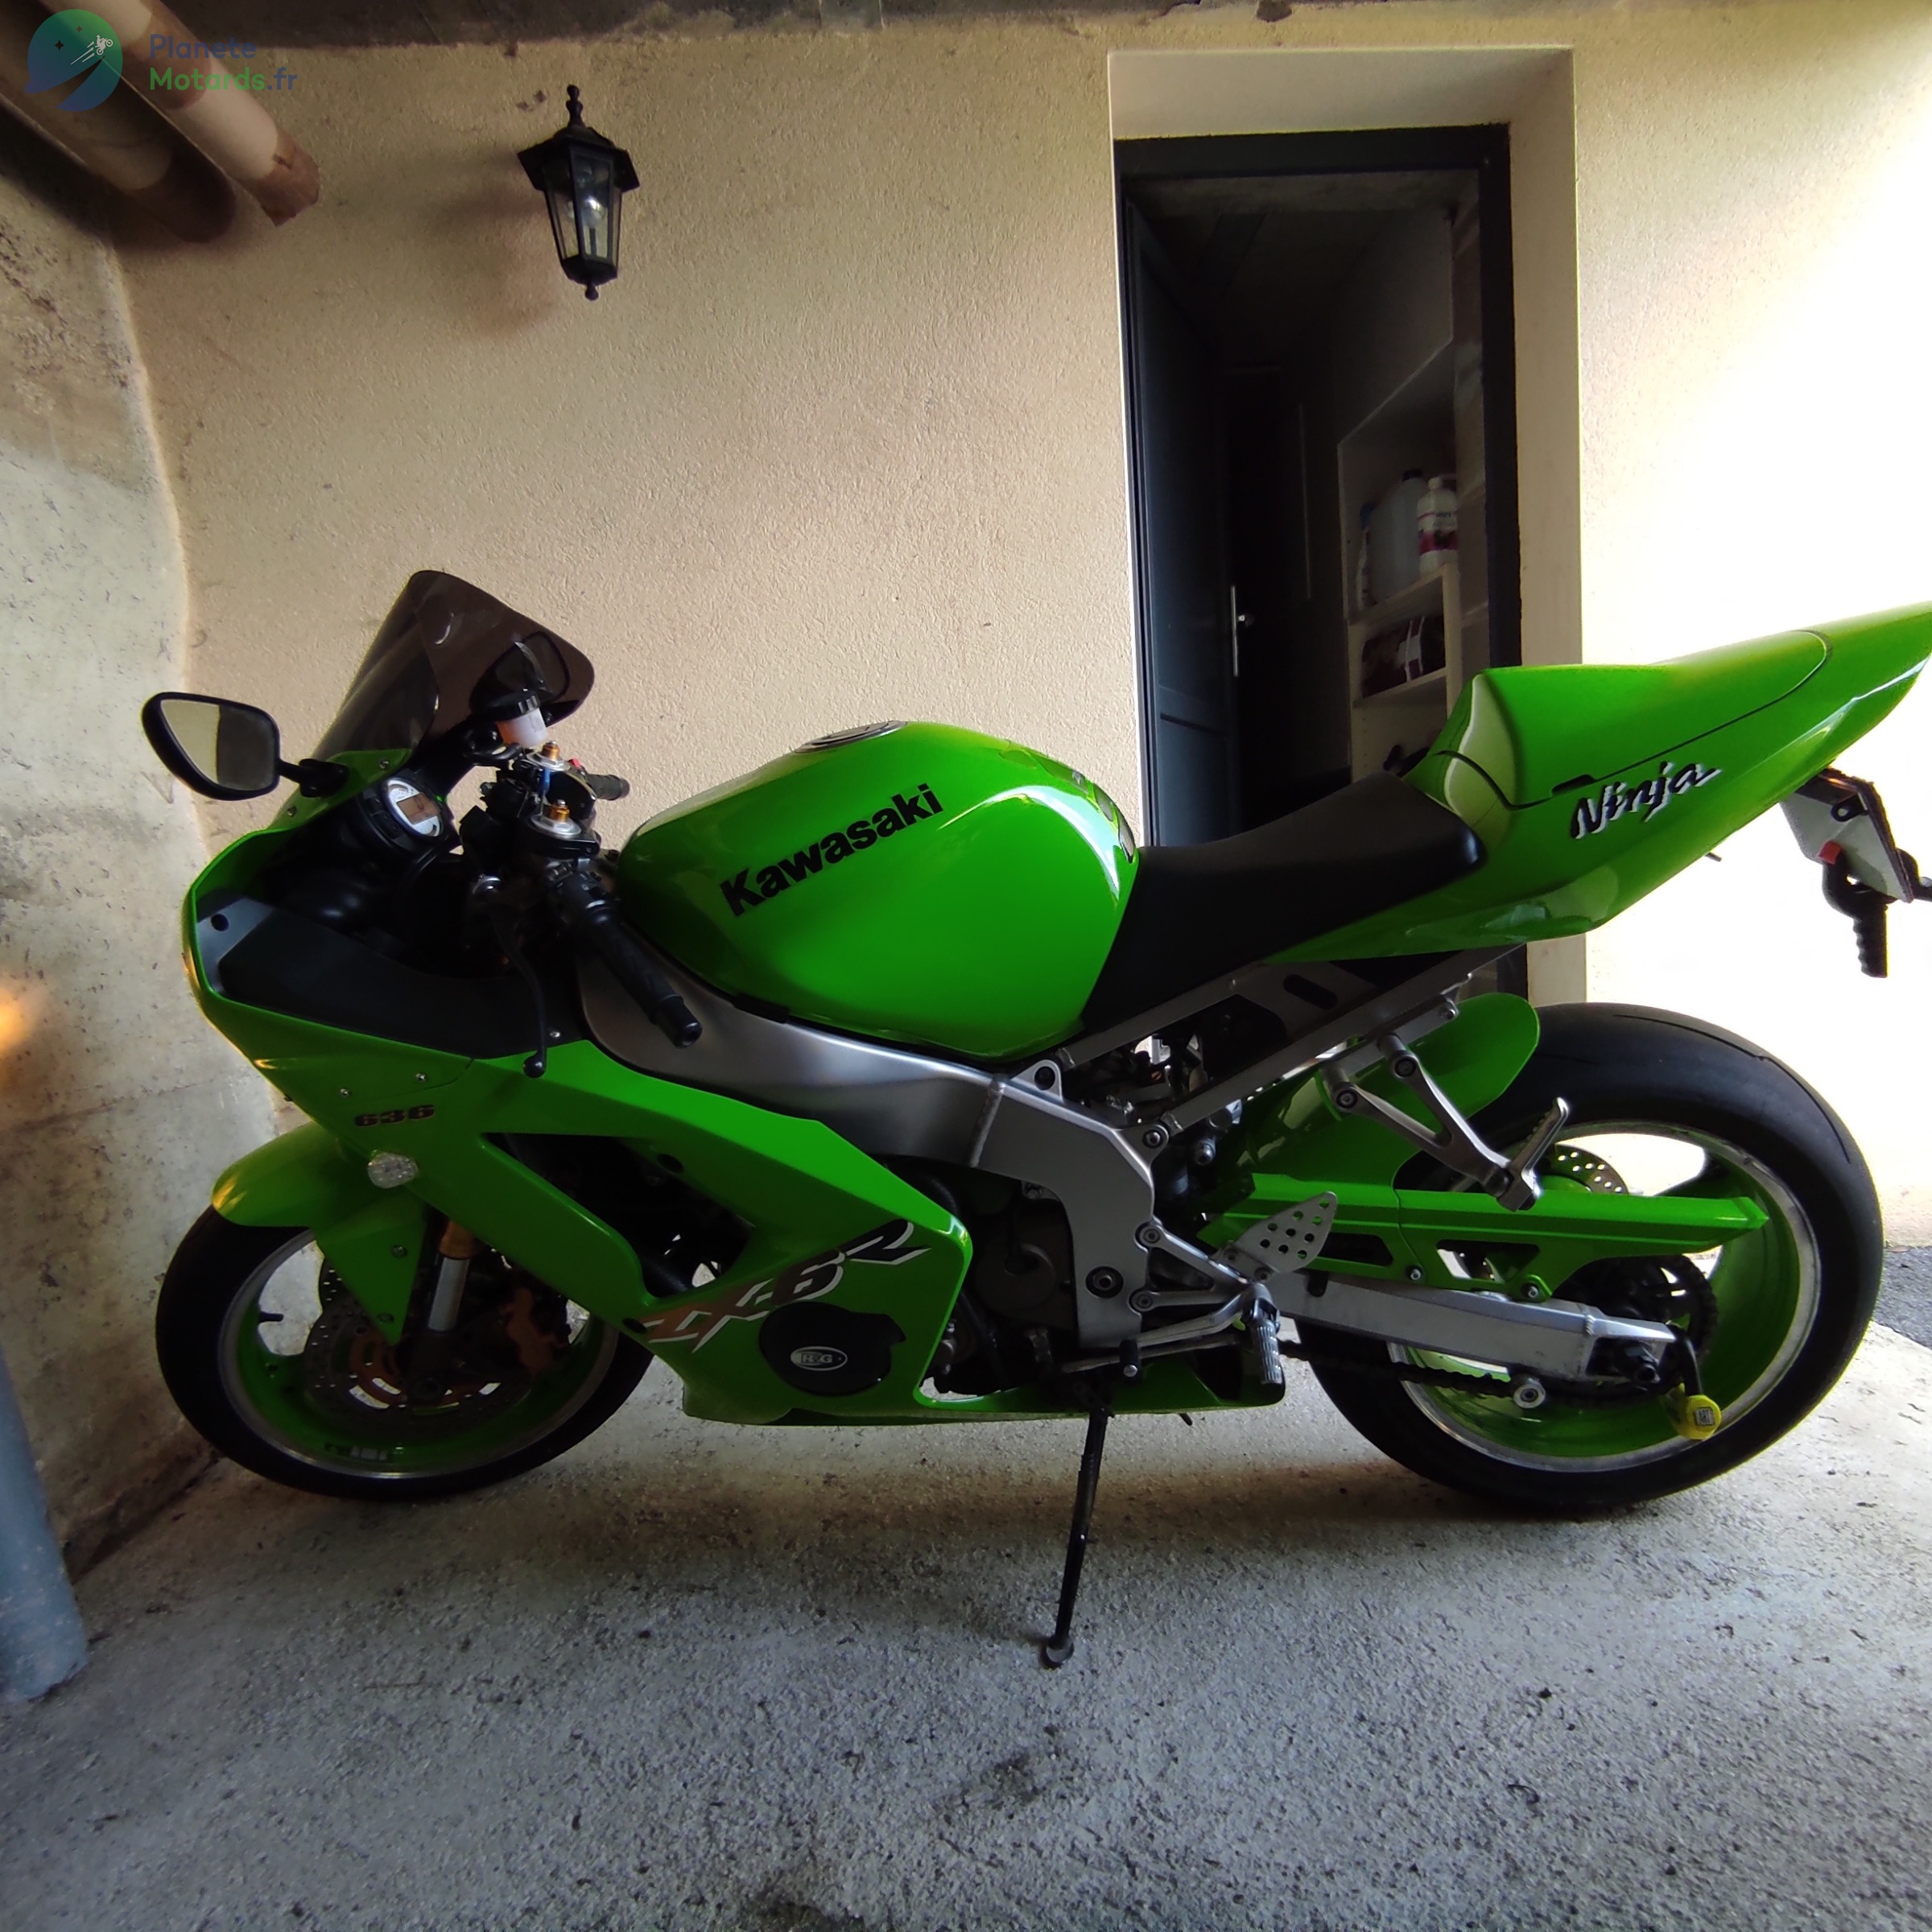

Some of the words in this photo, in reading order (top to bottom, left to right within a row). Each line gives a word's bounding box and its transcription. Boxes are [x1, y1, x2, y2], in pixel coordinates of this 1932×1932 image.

[1571, 761, 1723, 839] Ninja
[719, 782, 943, 917] Kawasaki
[354, 1104, 435, 1127] 636
